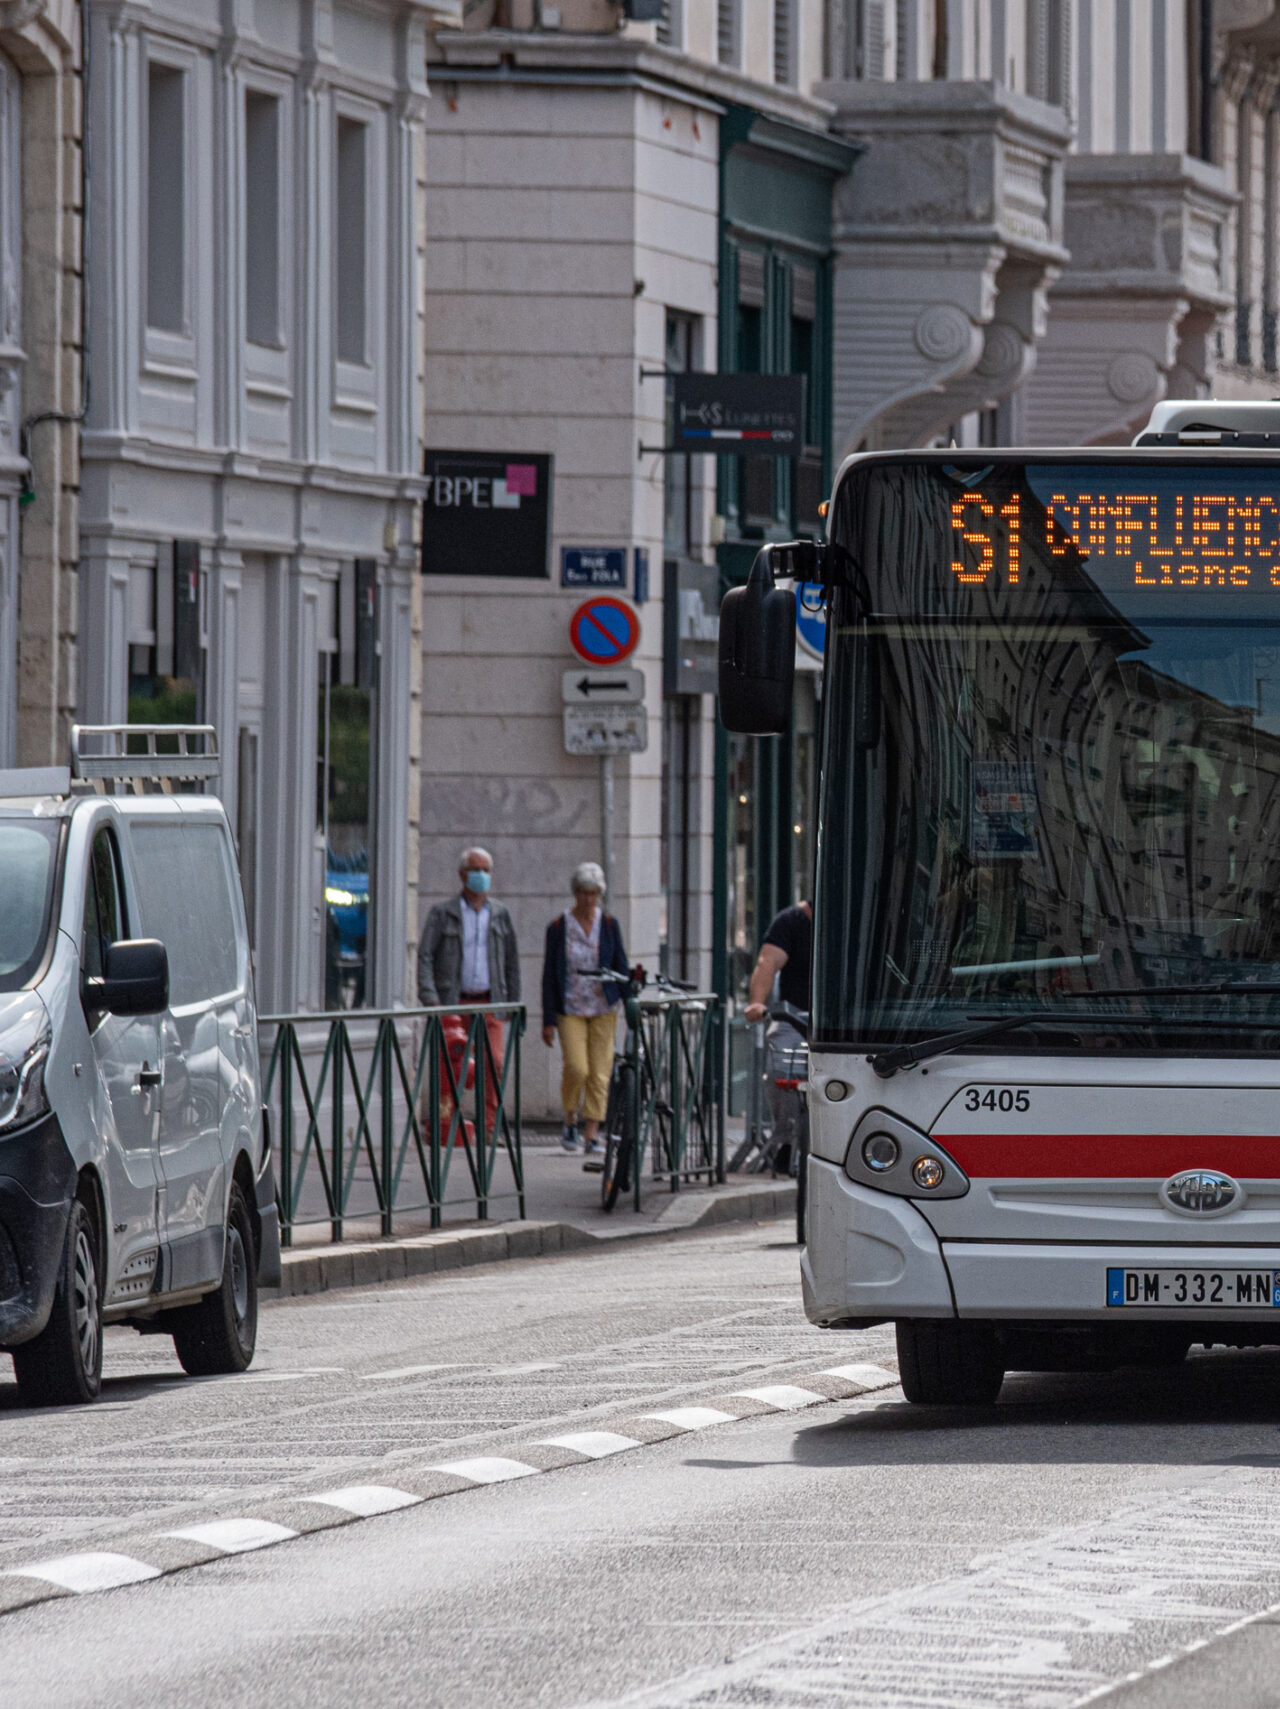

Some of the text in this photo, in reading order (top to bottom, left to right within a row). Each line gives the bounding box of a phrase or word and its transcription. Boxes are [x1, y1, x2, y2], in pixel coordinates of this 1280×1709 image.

[434, 476, 490, 509] BPE
[951, 493, 1021, 585] S1
[580, 555, 606, 568] RUE
[965, 1089, 1030, 1112] 3405
[1112, 1291, 1119, 1300] F
[1126, 1273, 1271, 1303] DM-332-MN
